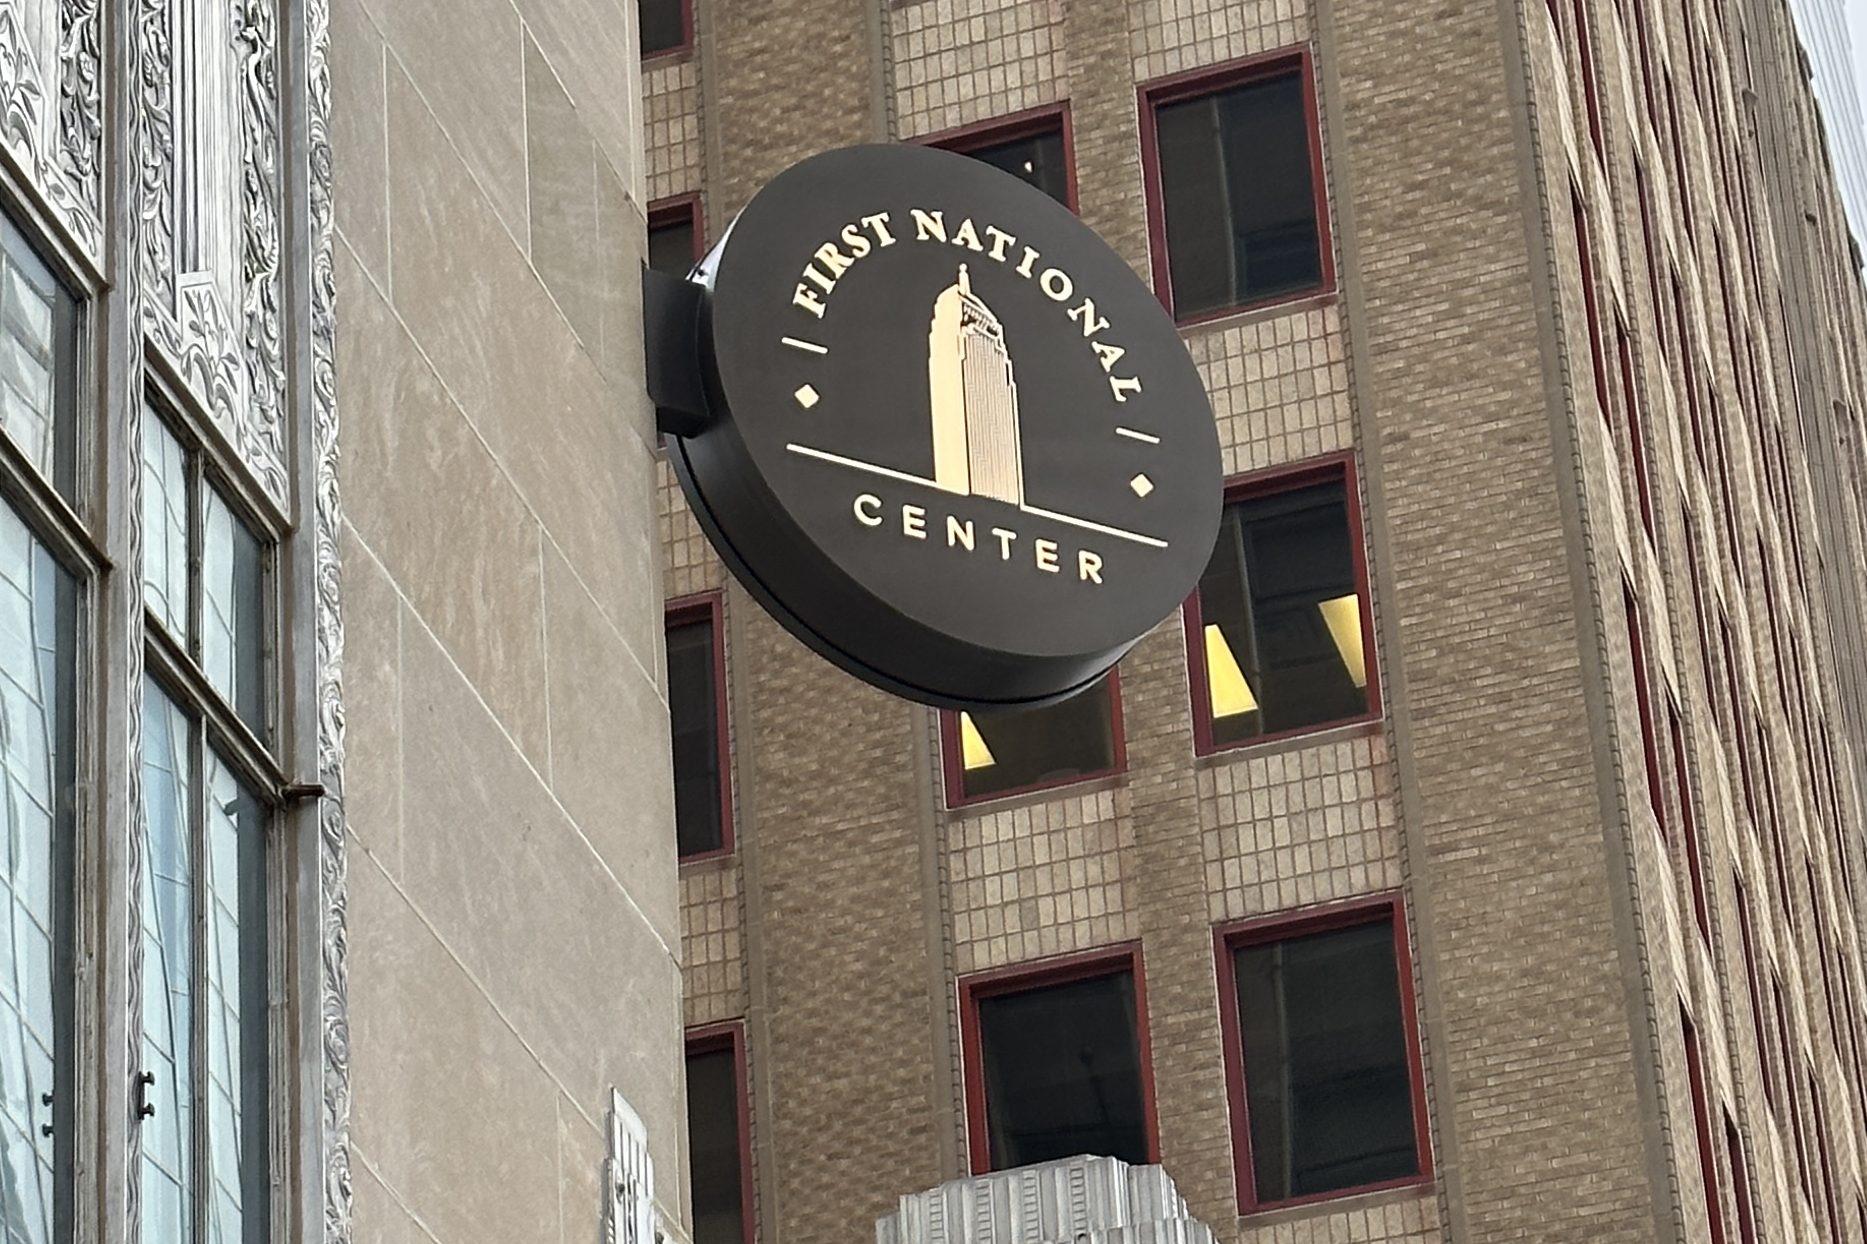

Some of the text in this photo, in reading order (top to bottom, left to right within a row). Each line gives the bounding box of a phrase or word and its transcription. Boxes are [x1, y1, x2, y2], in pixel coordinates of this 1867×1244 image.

[792, 208, 1142, 403] FIRST NATIONAL
[853, 493, 1103, 585] CENTER
